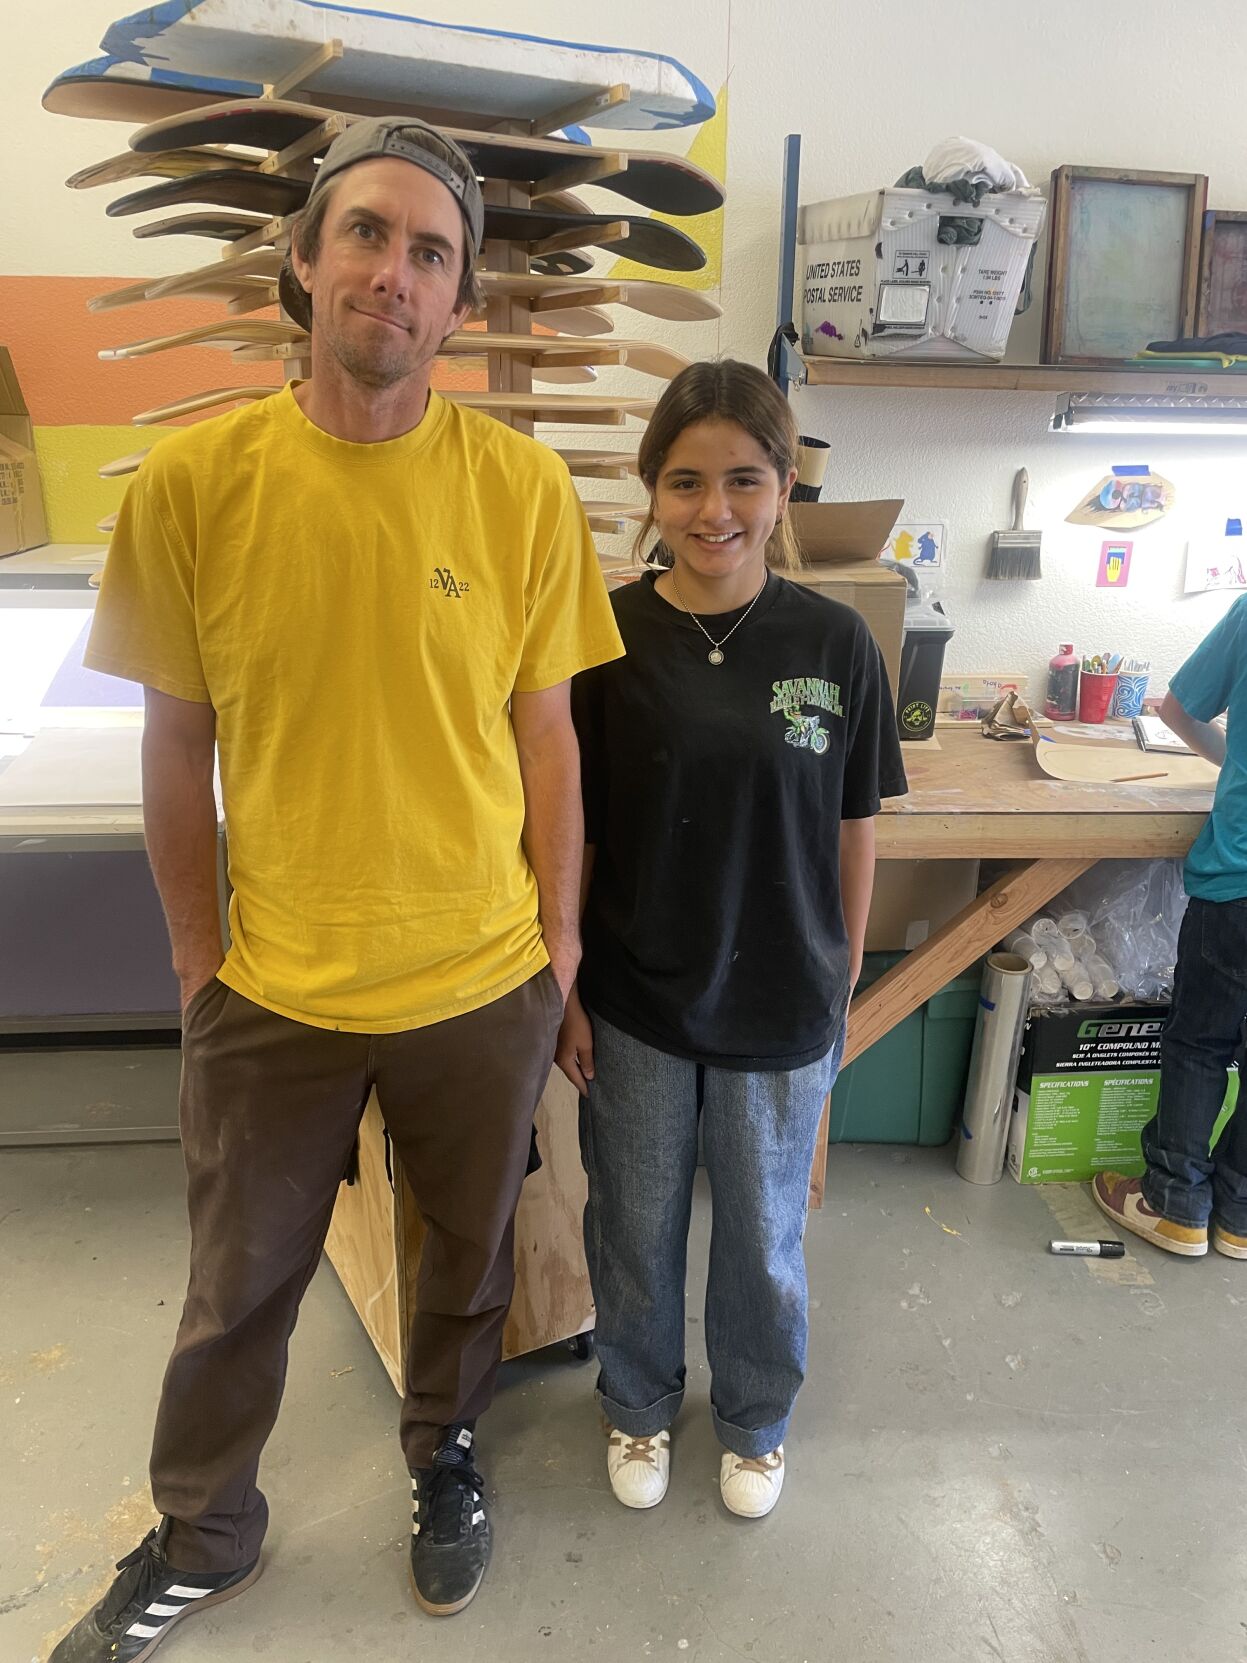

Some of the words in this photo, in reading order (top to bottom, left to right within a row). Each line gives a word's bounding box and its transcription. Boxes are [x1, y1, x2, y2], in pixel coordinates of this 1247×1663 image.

[806, 262, 830, 281] UNITED
[830, 259, 861, 278] STATES
[803, 287, 826, 304] POSTAL
[828, 285, 863, 303] SERVICE
[429, 578, 439, 589] 12
[434, 567, 461, 598] VA
[458, 581, 470, 592] 22
[772, 677, 840, 704] SAVANNAH
[1077, 1018, 1163, 1038] Gene
[1097, 1041, 1149, 1050] COMPOUND
[1039, 1080, 1089, 1089] SPECIFICATIONS
